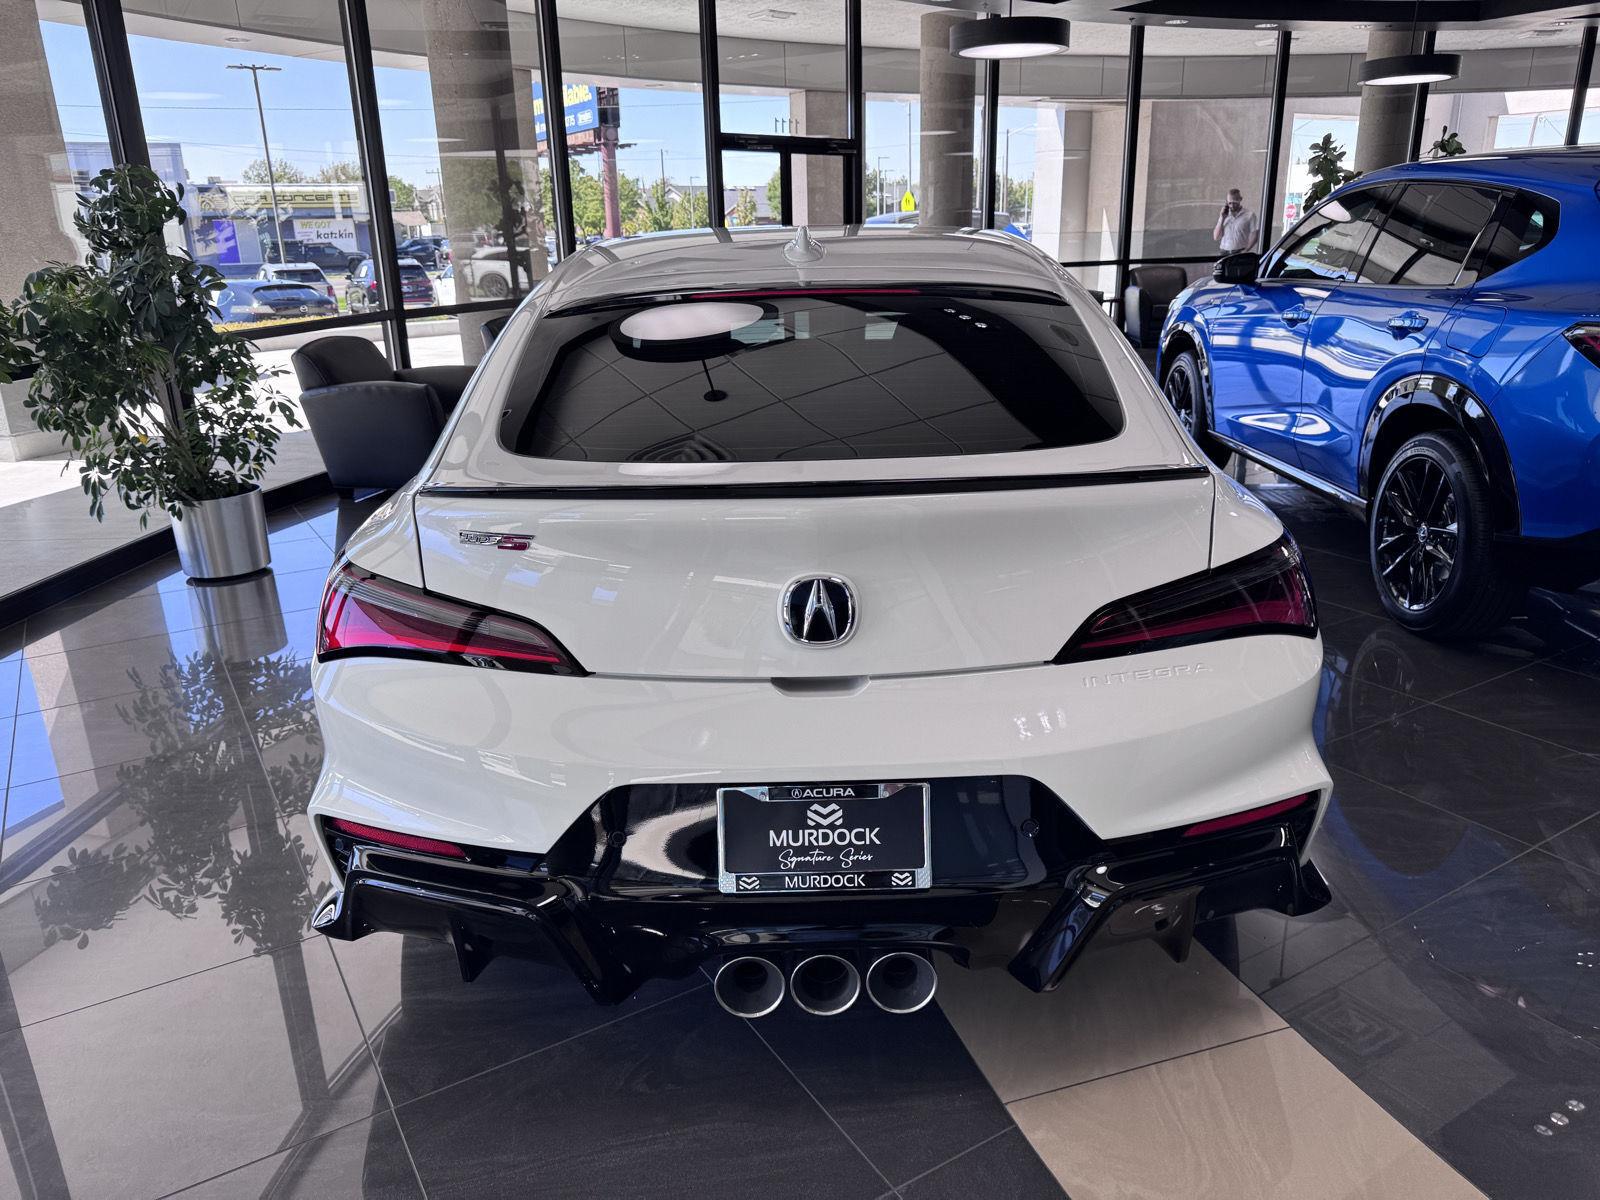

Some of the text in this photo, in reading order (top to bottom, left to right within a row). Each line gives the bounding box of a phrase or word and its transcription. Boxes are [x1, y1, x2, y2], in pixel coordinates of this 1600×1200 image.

[316, 228, 354, 240] katzkin
[1082, 662, 1213, 688] INTEGRA
[802, 787, 856, 798] ACURA
[769, 827, 882, 847] MURDOCK
[778, 847, 874, 870] Signature Series
[785, 873, 866, 889] MURDOCK
